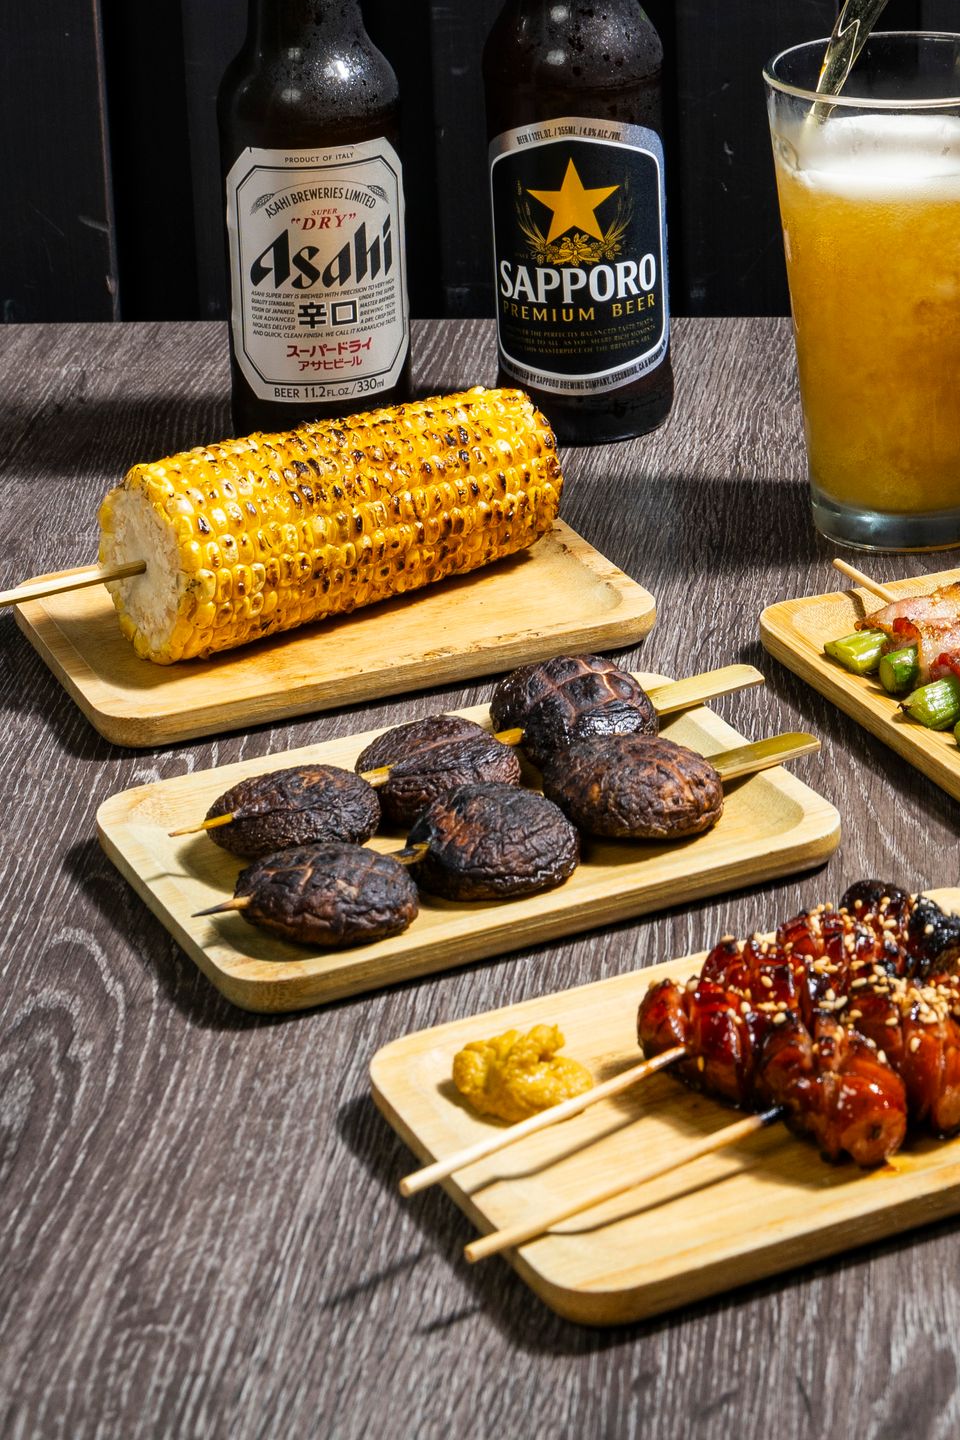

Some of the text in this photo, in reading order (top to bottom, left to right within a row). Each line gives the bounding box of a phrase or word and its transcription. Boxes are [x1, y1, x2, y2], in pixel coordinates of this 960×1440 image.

[264, 188, 376, 219] ASAHI BREWERIES LIMITED
[311, 208, 338, 216] SUPER
[250, 214, 393, 289] Asahi
[500, 253, 657, 304] SAPPORO
[340, 287, 367, 296] PRECISION
[298, 300, 357, 329] 辛口
[360, 306, 383, 316] BREWING
[503, 294, 656, 322] PREMIUM BEER
[287, 337, 372, 357] スーパードライ
[298, 356, 362, 372] アサヒビール
[274, 388, 300, 398] BEER
